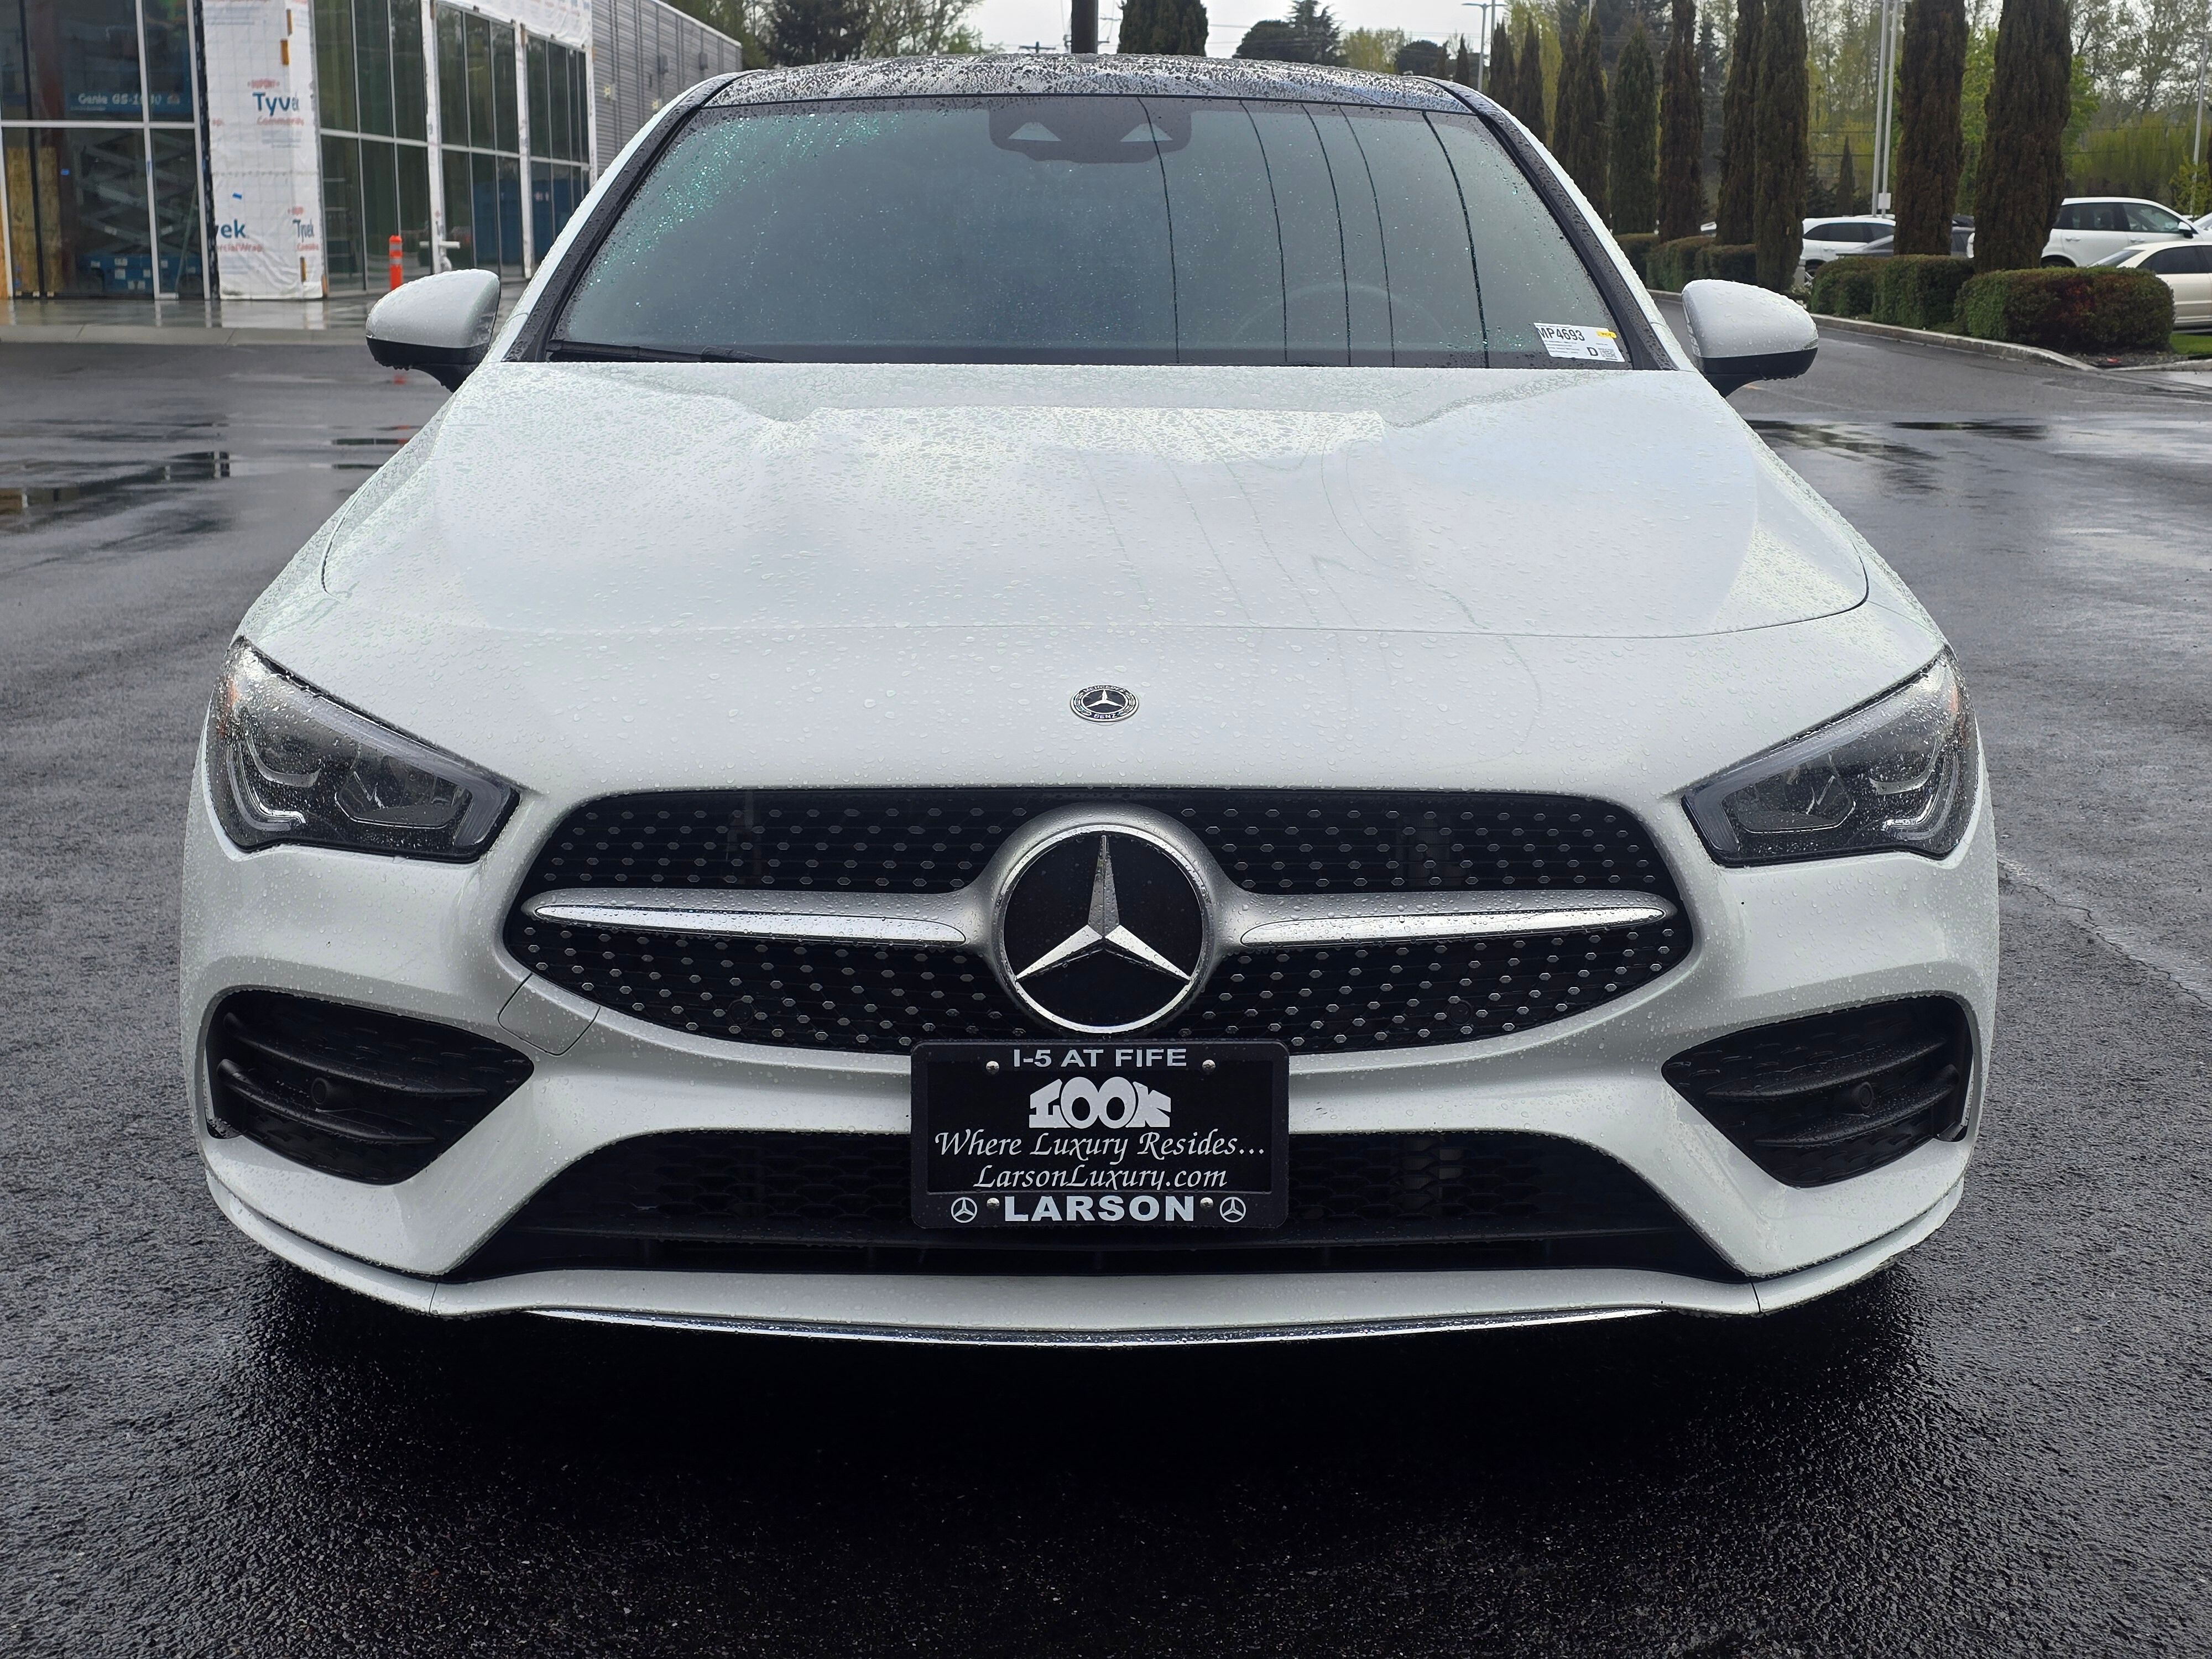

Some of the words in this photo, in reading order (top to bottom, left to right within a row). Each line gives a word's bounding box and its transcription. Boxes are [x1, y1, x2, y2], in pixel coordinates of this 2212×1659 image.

[1587, 347, 1599, 356] D
[1014, 1049, 1052, 1067] I-5
[1061, 1049, 1104, 1067] AT
[1115, 1048, 1187, 1067] FIFE
[935, 1129, 1022, 1156] Where
[1029, 1133, 1129, 1165] Luxury
[1136, 1128, 1264, 1160] Resides...
[973, 1164, 1228, 1191] LarsonLuxury.com
[1005, 1195, 1194, 1222] LARSON
